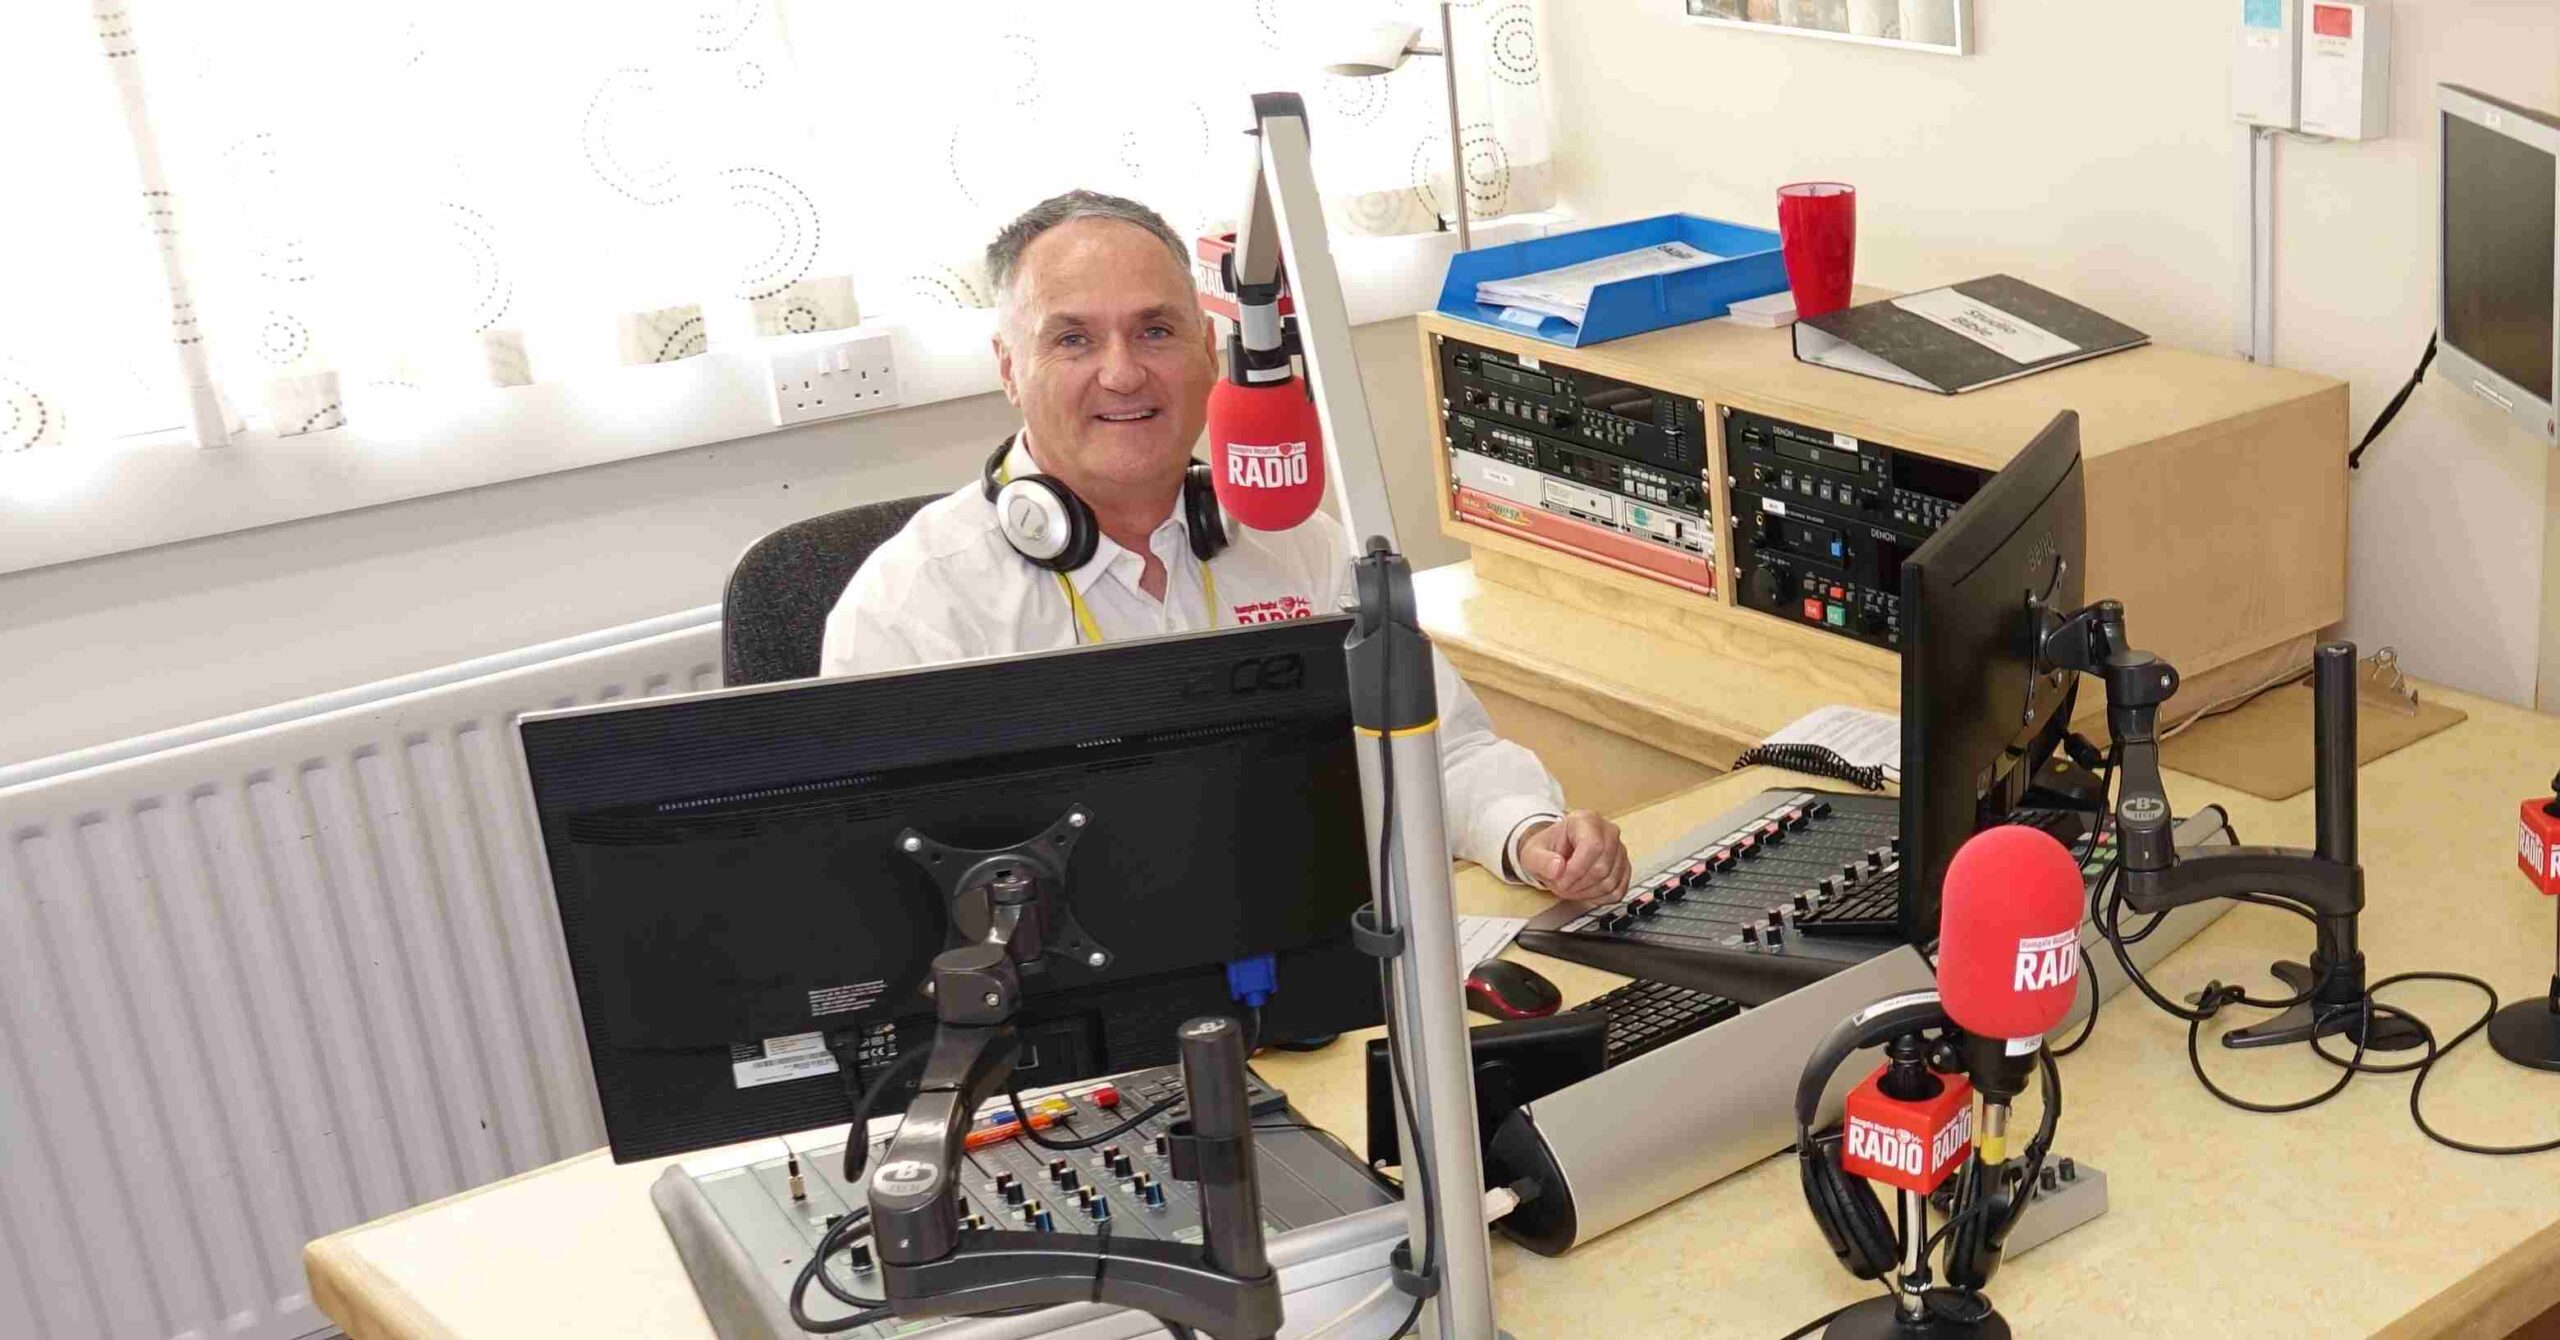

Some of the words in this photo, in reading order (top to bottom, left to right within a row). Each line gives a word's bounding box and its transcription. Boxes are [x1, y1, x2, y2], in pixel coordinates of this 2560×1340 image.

[1950, 316, 1993, 336] Bible
[1963, 310, 2017, 334] Studio
[1772, 426, 1795, 438] DENON
[1227, 453, 1308, 488] RADIO
[1871, 528, 1897, 543] DENON
[2519, 824, 2544, 877] RADIO
[1848, 1124, 1924, 1176] RADIO
[1931, 1111, 1972, 1175] RADIO
